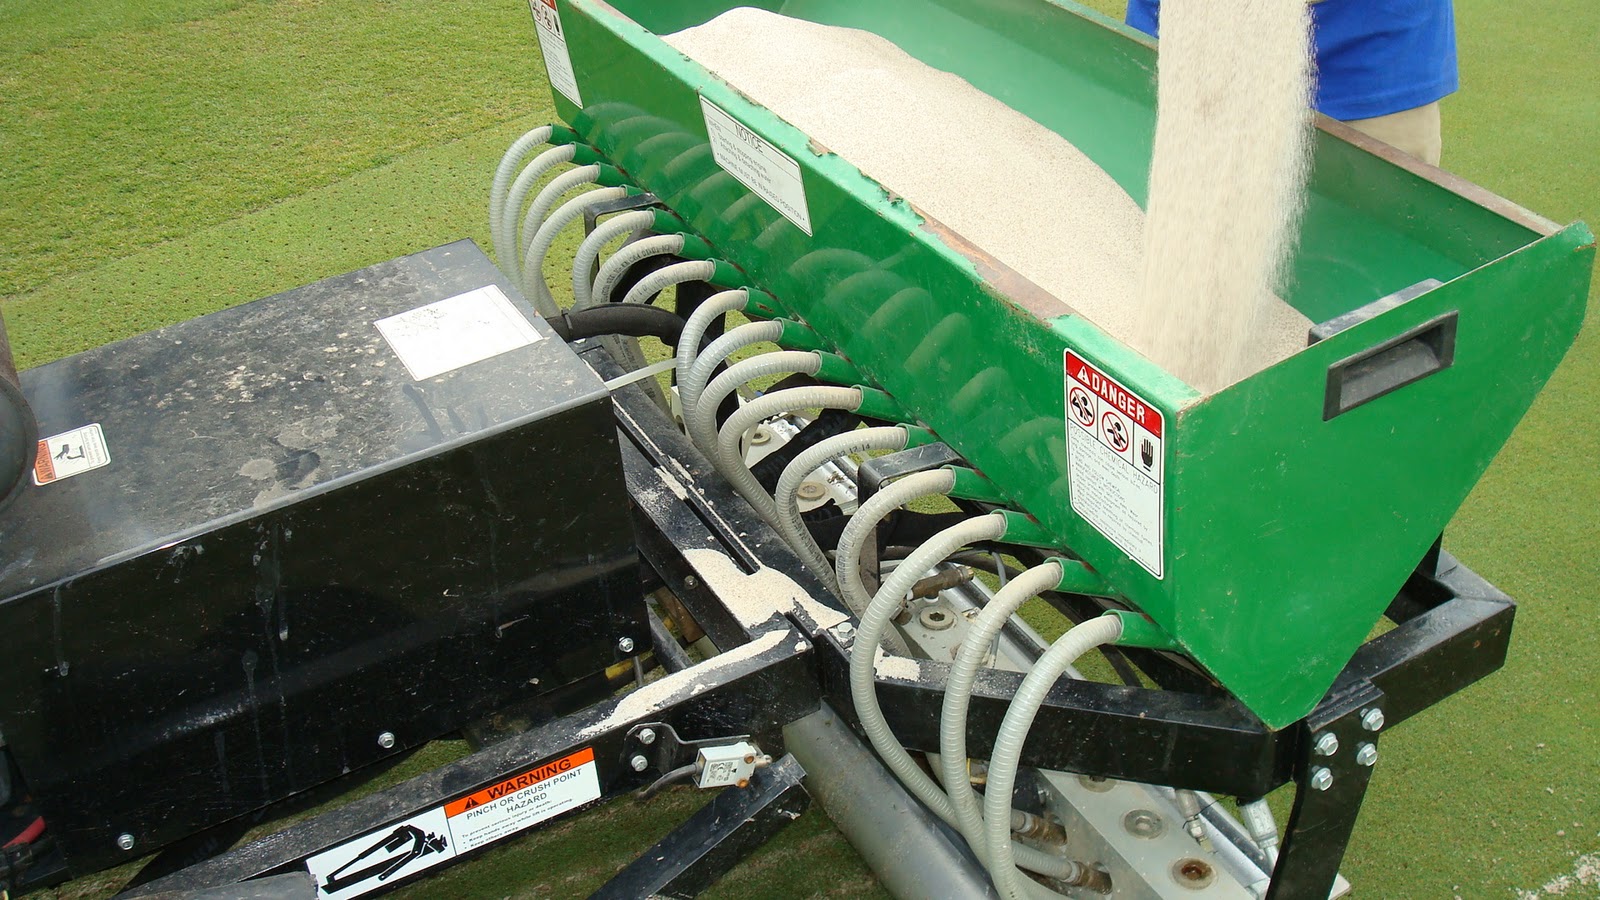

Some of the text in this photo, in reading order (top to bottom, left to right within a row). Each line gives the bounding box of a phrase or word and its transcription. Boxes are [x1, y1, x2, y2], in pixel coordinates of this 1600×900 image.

[735, 124, 763, 153] NOTICE
[1092, 371, 1146, 424] DANGER
[466, 768, 582, 820] PINCH OR CRUSH POINT
[487, 757, 571, 800] WARNING
[506, 791, 547, 814] HAZARD
